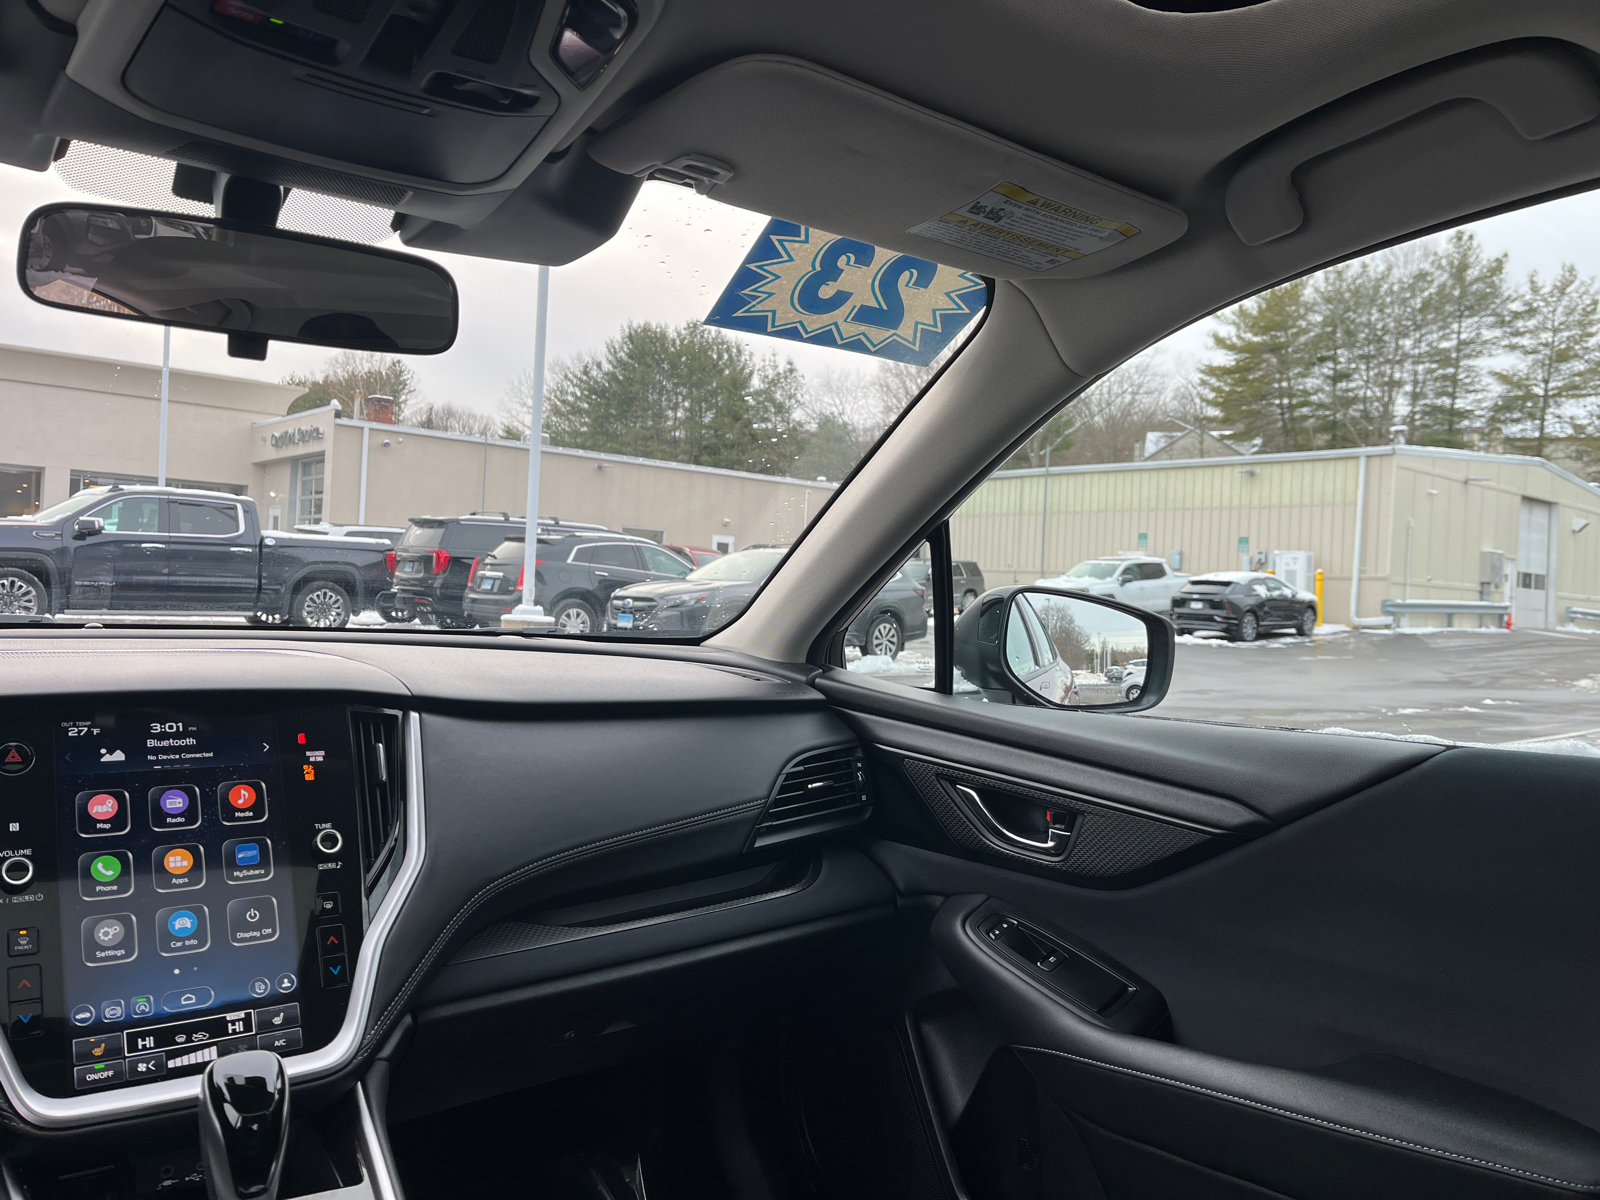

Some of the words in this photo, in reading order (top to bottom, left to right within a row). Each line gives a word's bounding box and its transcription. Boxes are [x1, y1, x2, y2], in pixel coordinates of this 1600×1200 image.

[1003, 199, 1024, 210] EVEN
[1023, 206, 1041, 216] WITH
[1042, 210, 1077, 227] ADVANCED
[1038, 198, 1103, 225] WARNING
[972, 222, 1073, 254] AVERTISSEMENT
[68, 727, 88, 736] 27
[150, 722, 184, 733] 3:01
[146, 738, 196, 748] Bluetooth
[234, 810, 254, 818] Media
[166, 816, 186, 824] Radio
[96, 822, 112, 830] Map
[0, 848, 32, 857] VOLUME
[318, 862, 336, 870] HOLD
[233, 868, 265, 878] MySubaru
[171, 876, 189, 885] Apps
[96, 884, 118, 892] Phone
[12, 894, 35, 903] HOLD
[236, 930, 261, 939] Display
[170, 940, 184, 948] Car
[184, 938, 198, 946] Info
[14, 944, 33, 952] FRONT
[95, 948, 126, 958] Settings
[228, 1020, 244, 1034] HI
[138, 1036, 155, 1050] HI
[274, 1038, 287, 1047] A/C
[86, 1070, 114, 1082] ON/OFF
